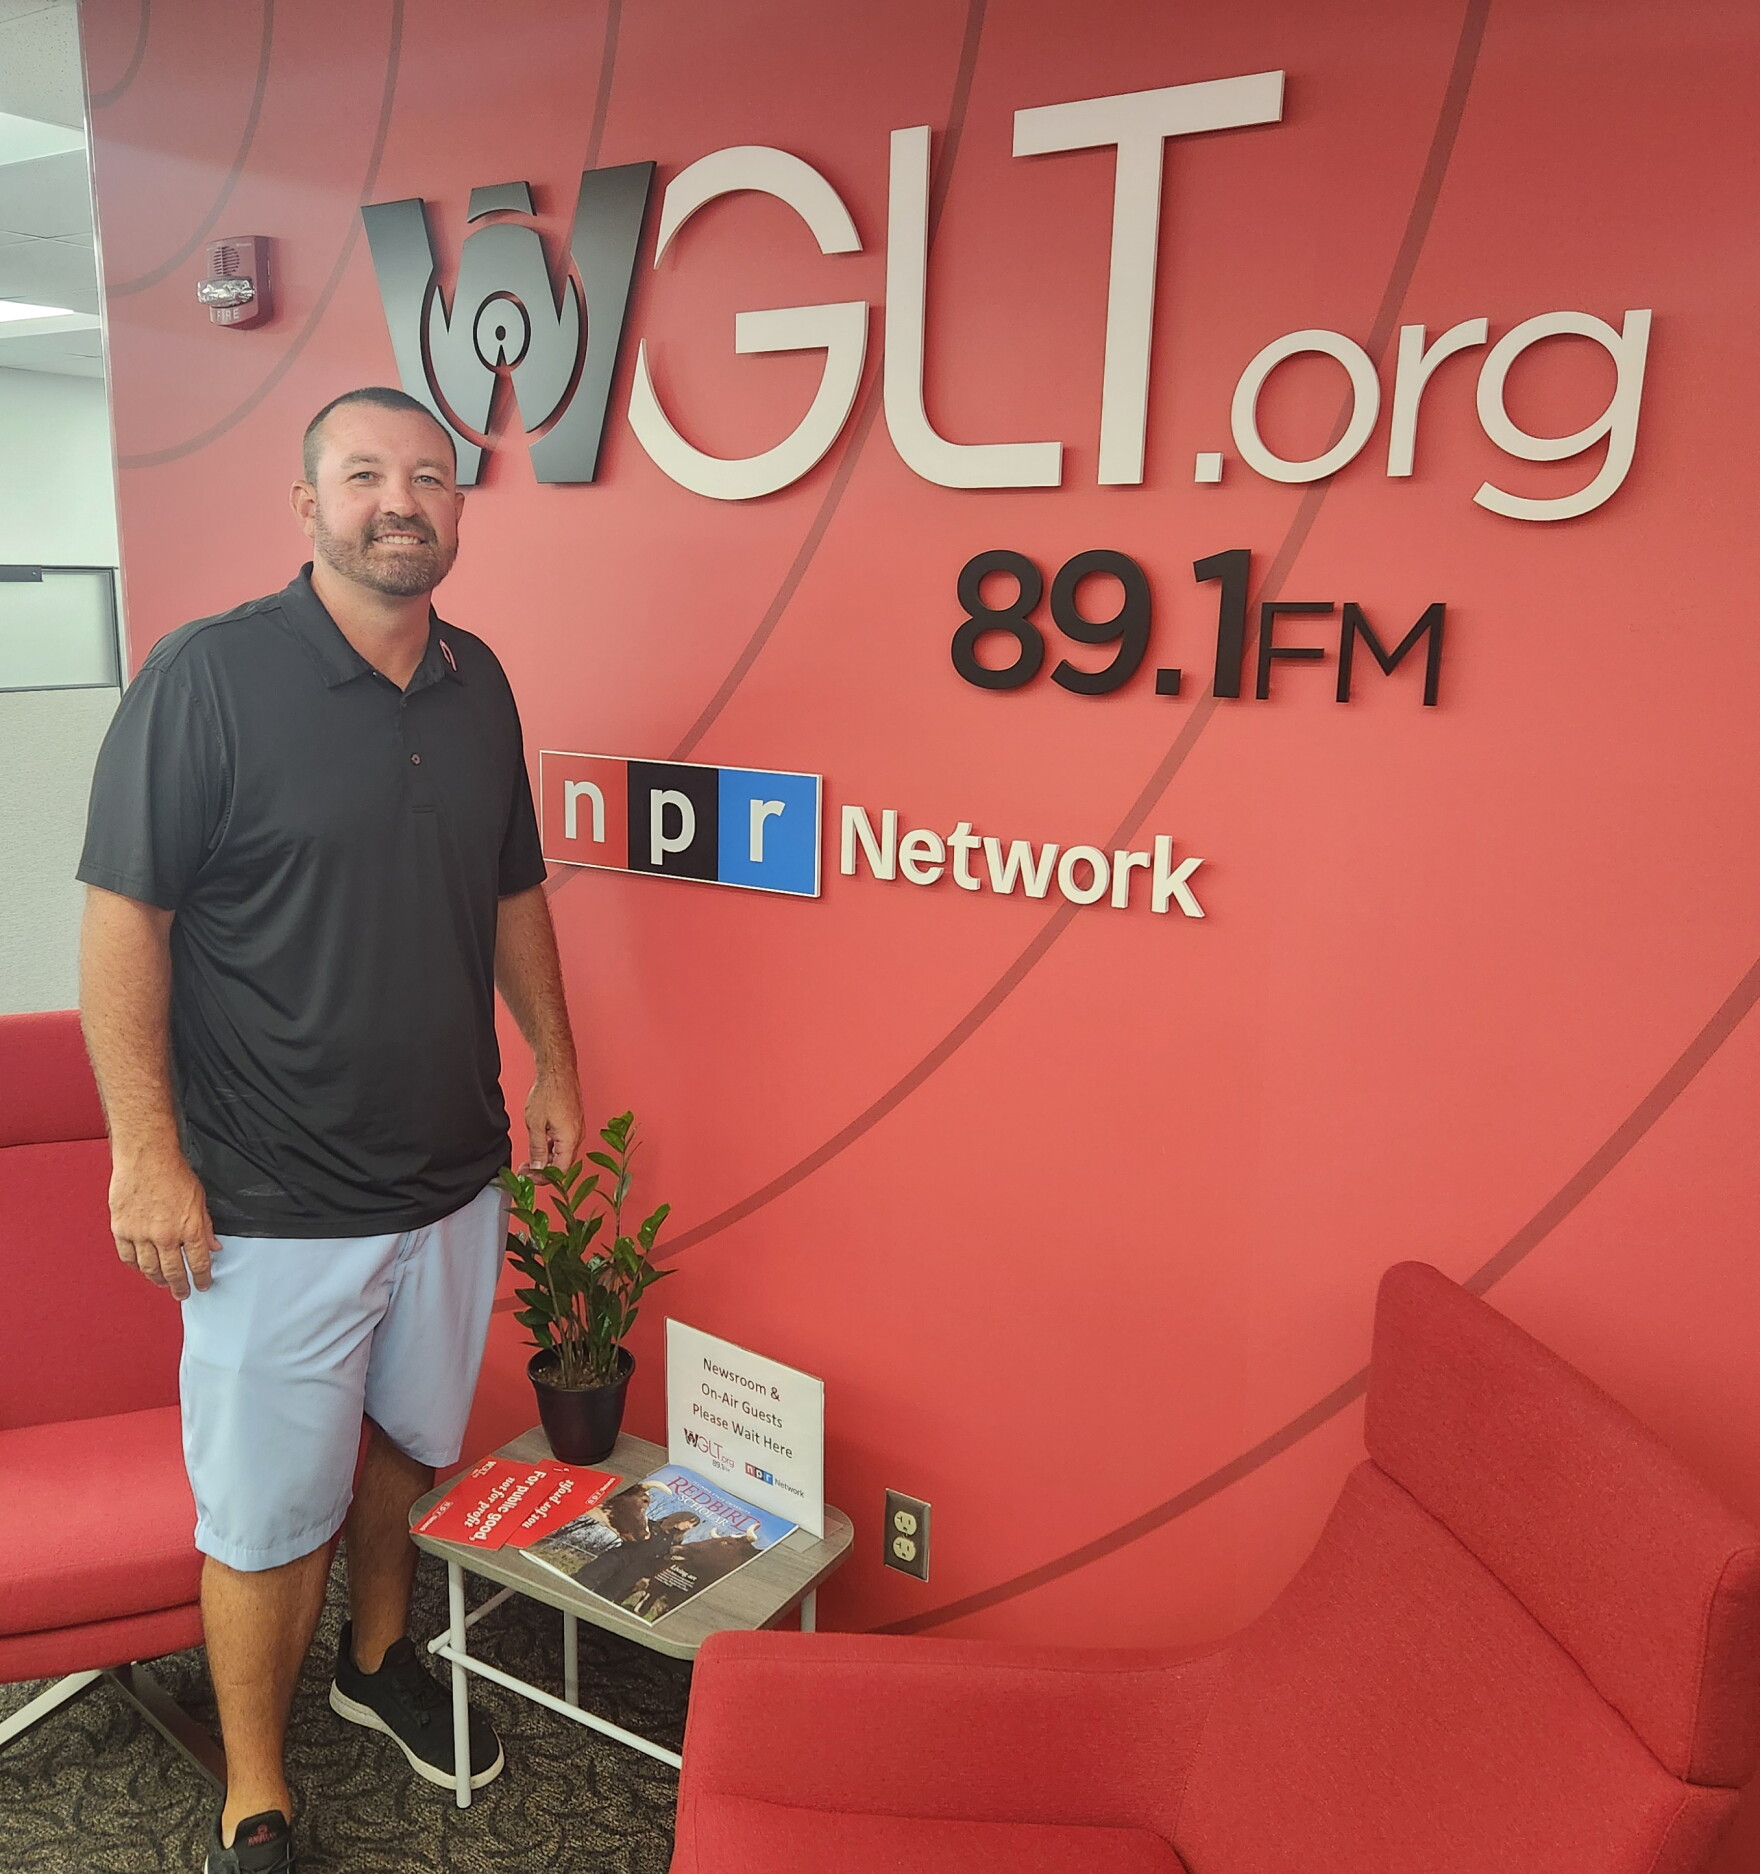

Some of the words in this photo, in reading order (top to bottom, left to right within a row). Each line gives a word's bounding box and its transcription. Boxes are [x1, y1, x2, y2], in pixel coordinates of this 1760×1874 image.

[216, 308, 240, 320] FIRE
[563, 779, 786, 865] npr
[840, 804, 1205, 918] Network
[703, 1357, 767, 1396] Newsroom
[771, 1386, 781, 1401] &
[701, 1383, 738, 1409] On-Air
[742, 1402, 783, 1428] Guests
[693, 1403, 729, 1430] Please
[732, 1421, 760, 1446] Wait
[764, 1436, 793, 1459] Here
[488, 1487, 505, 1503] for
[499, 1477, 516, 1491] not
[525, 1471, 547, 1487] For
[747, 1464, 772, 1484] npr
[774, 1478, 805, 1498] Network
[464, 1501, 490, 1528] profit
[498, 1484, 530, 1513] public
[521, 1515, 540, 1529] not
[534, 1502, 552, 1518] for
[549, 1479, 575, 1505] profit
[667, 1475, 761, 1532] REDBIRD
[677, 1494, 728, 1527] SCHOLAR
[469, 1512, 503, 1541] good,
